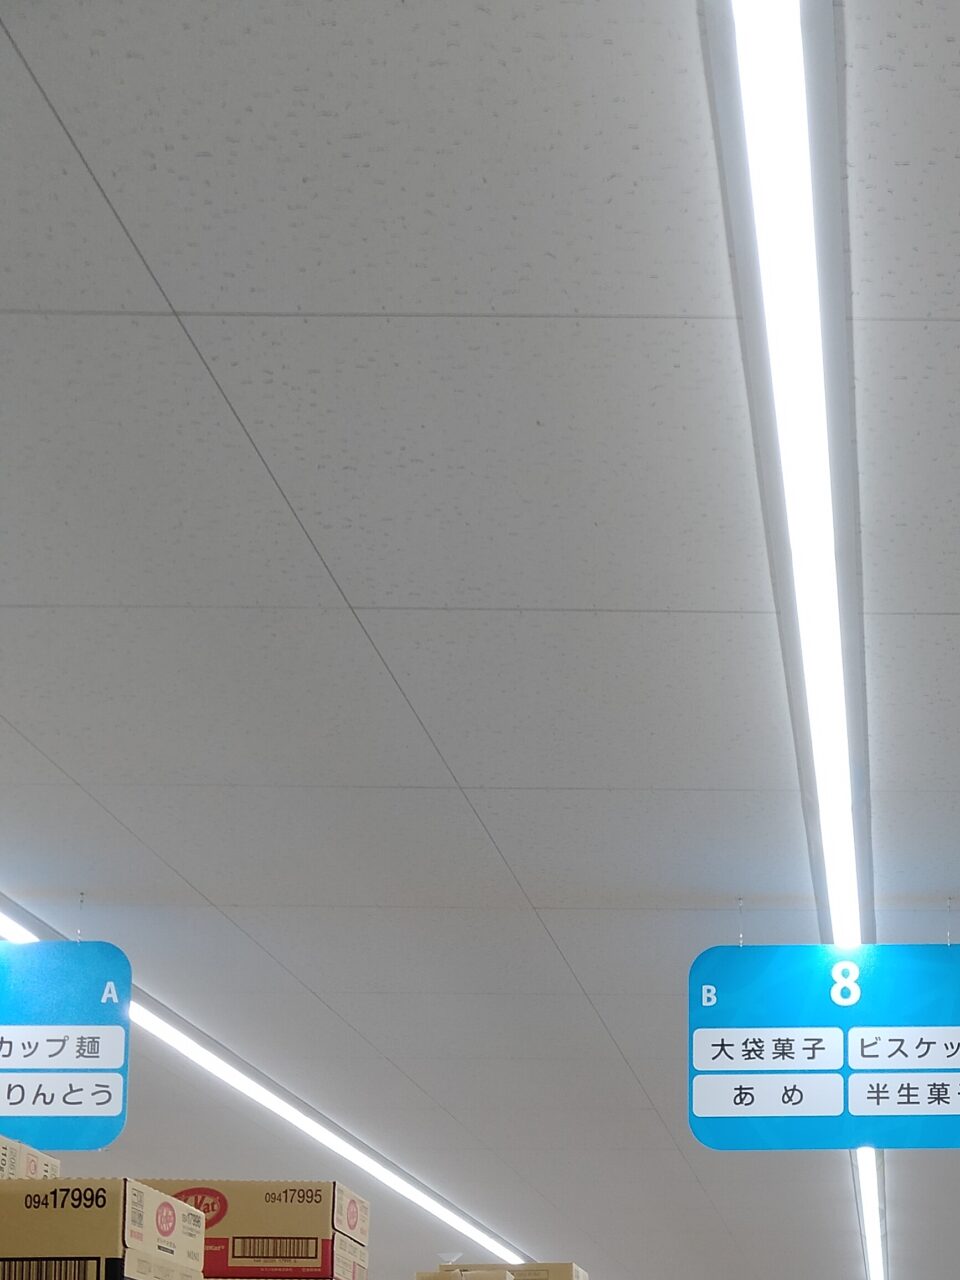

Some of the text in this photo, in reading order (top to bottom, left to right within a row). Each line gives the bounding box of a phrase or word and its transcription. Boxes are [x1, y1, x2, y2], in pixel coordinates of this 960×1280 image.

[101, 982, 119, 1003] A
[830, 961, 861, 1006] 8
[702, 985, 717, 1006] B
[711, 1038, 825, 1061] 大袋菓子
[7, 1084, 113, 1106] りんとう
[733, 1085, 804, 1107] あめ
[24, 1187, 107, 1210] 09417996
[264, 1188, 322, 1205] 09417995
